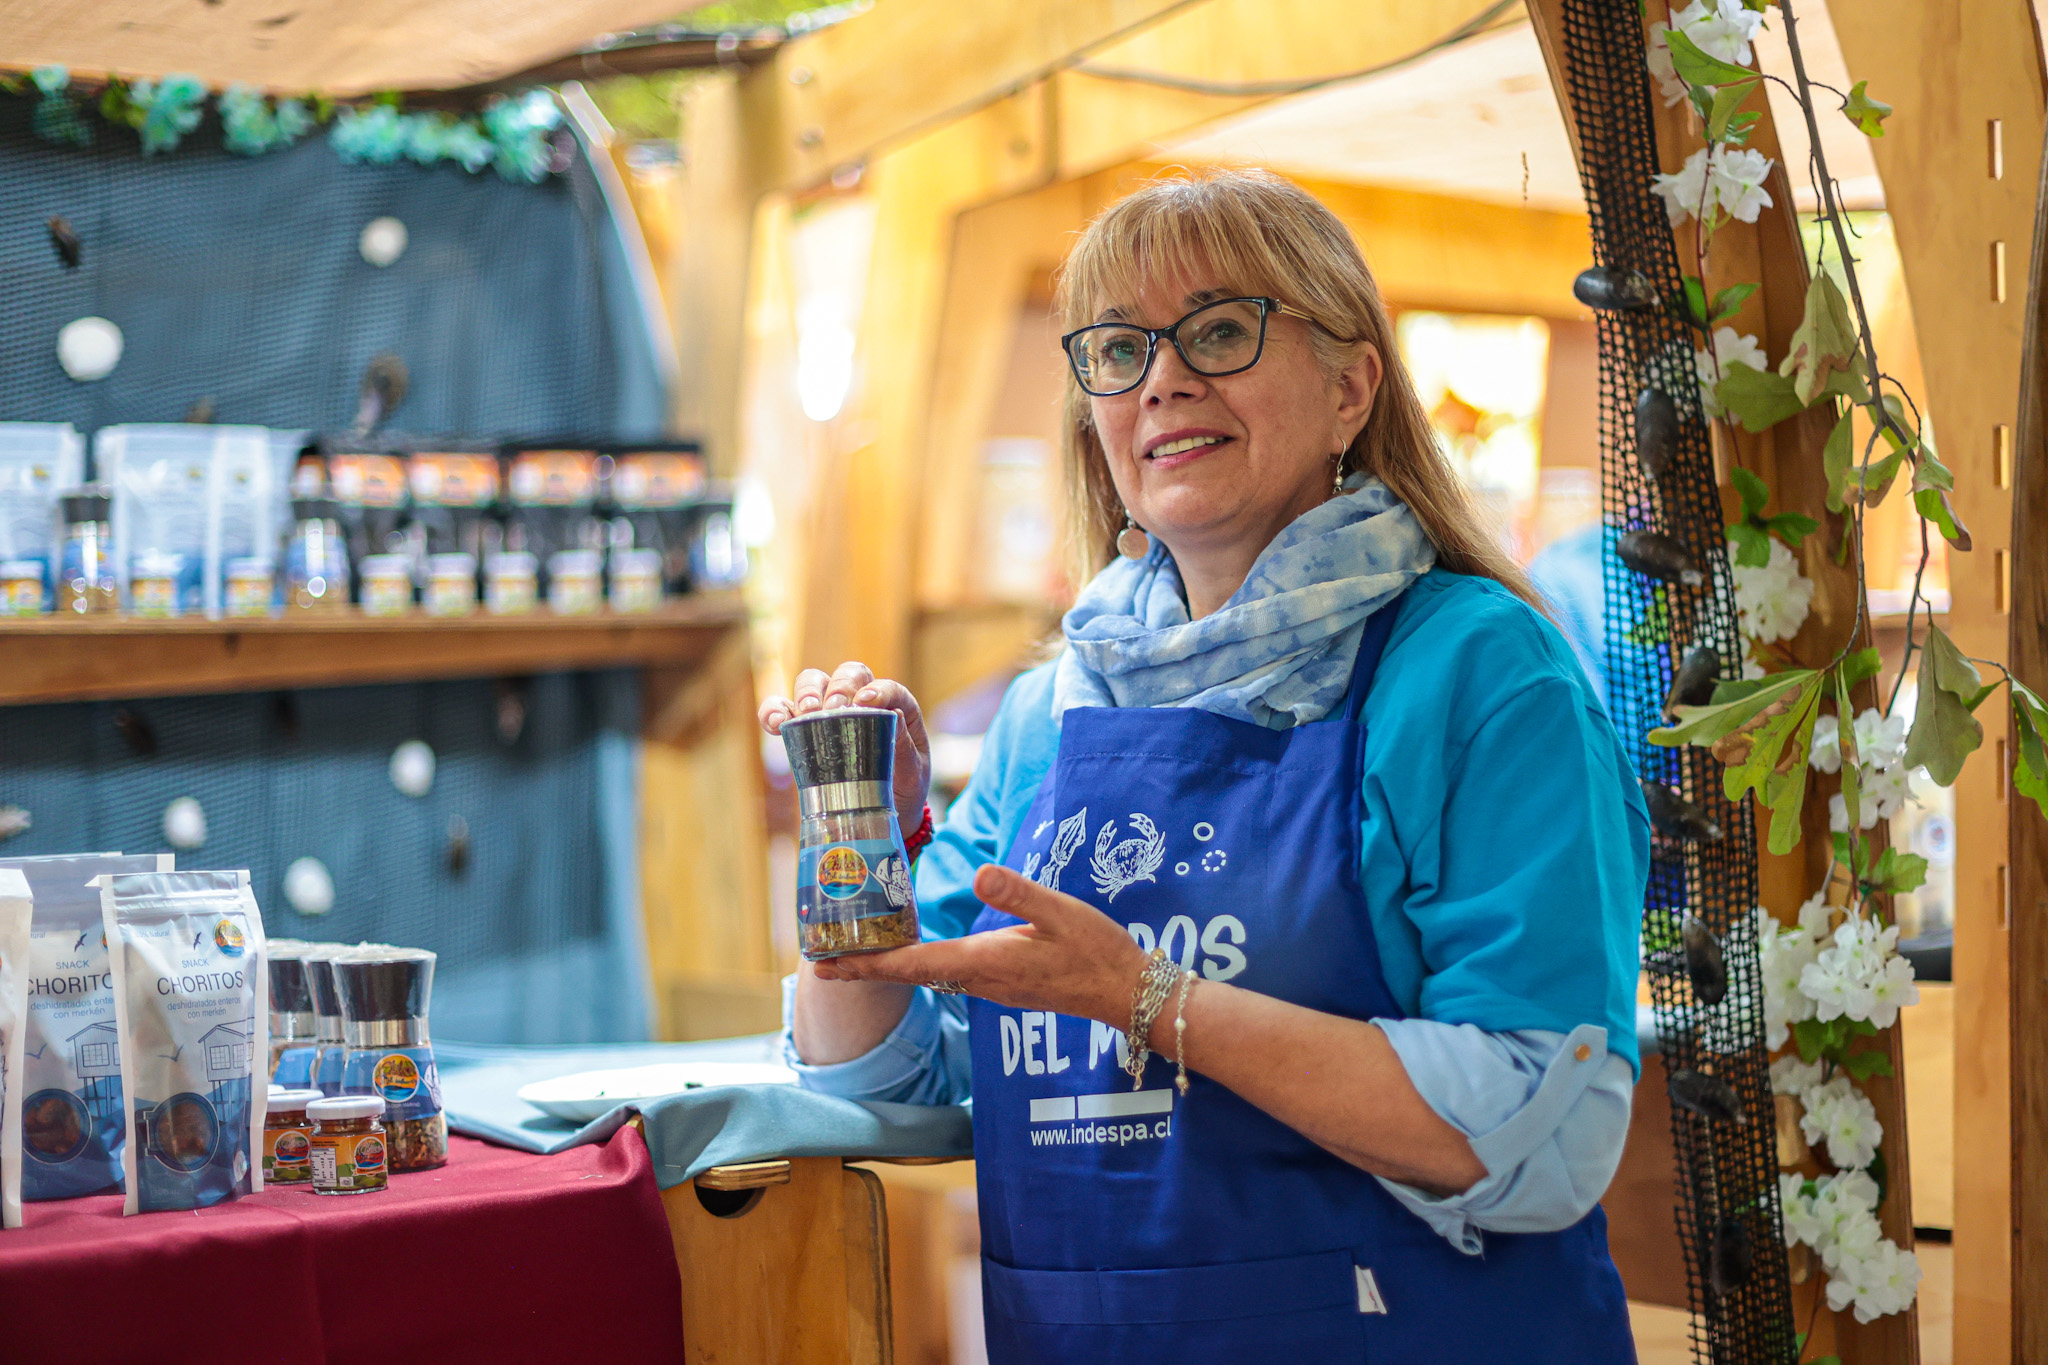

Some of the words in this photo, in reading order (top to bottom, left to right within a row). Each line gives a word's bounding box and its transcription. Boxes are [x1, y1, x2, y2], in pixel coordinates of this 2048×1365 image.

[55, 959, 90, 970] SNACK
[181, 958, 210, 969] SNACK
[157, 970, 244, 996] CHORITOS
[30, 1000, 92, 1011] deshidratados
[167, 998, 217, 1011] deshidratados
[218, 996, 241, 1006] enteros
[53, 1011, 70, 1019] con
[72, 1007, 106, 1018] merkén
[187, 1011, 201, 1019] con
[202, 1007, 227, 1018] merkén
[1000, 1010, 1071, 1077] DEL
[1030, 1115, 1172, 1147] www.indespa.cl
